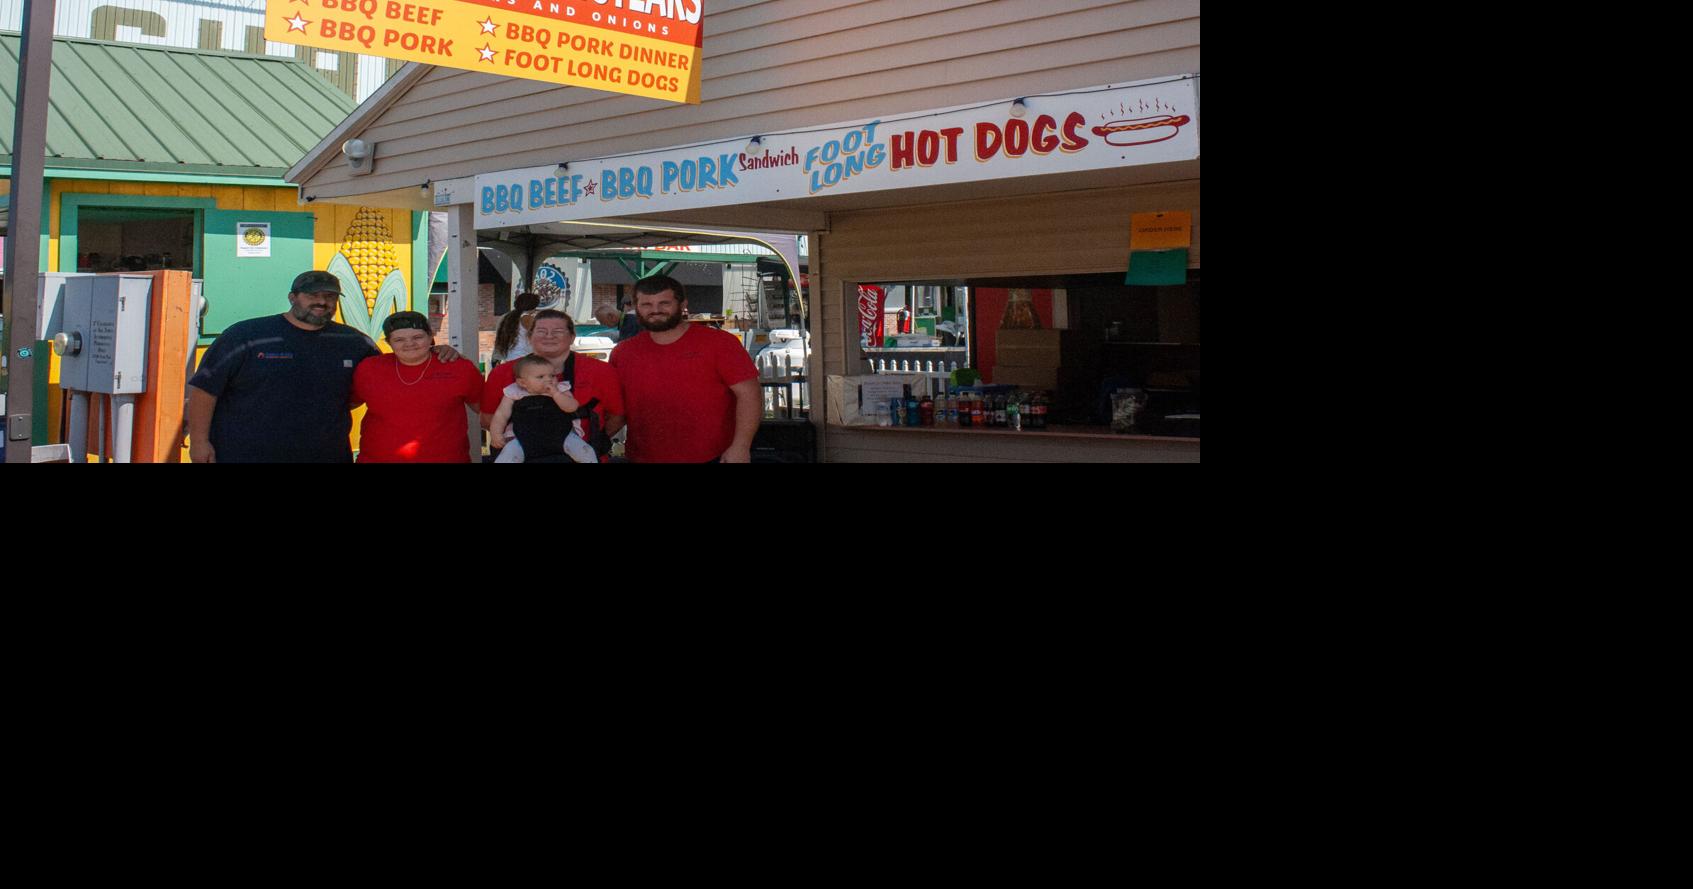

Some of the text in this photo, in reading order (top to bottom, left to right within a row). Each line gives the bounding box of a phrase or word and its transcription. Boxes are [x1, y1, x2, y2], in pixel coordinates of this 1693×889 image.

[320, 18, 454, 57] BBQ PORK
[385, 0, 444, 26] BEEF
[533, 0, 670, 36] AND ONIONS
[504, 49, 682, 93] FOOT LONG DOGS
[506, 22, 689, 71] BBQ PORK DINNER
[803, 119, 881, 173] FOOT
[890, 111, 1089, 171] HOT DOGS
[481, 146, 800, 215] BBQ BEEF BBQ PORK Sandwich
[809, 142, 887, 194] LONG
